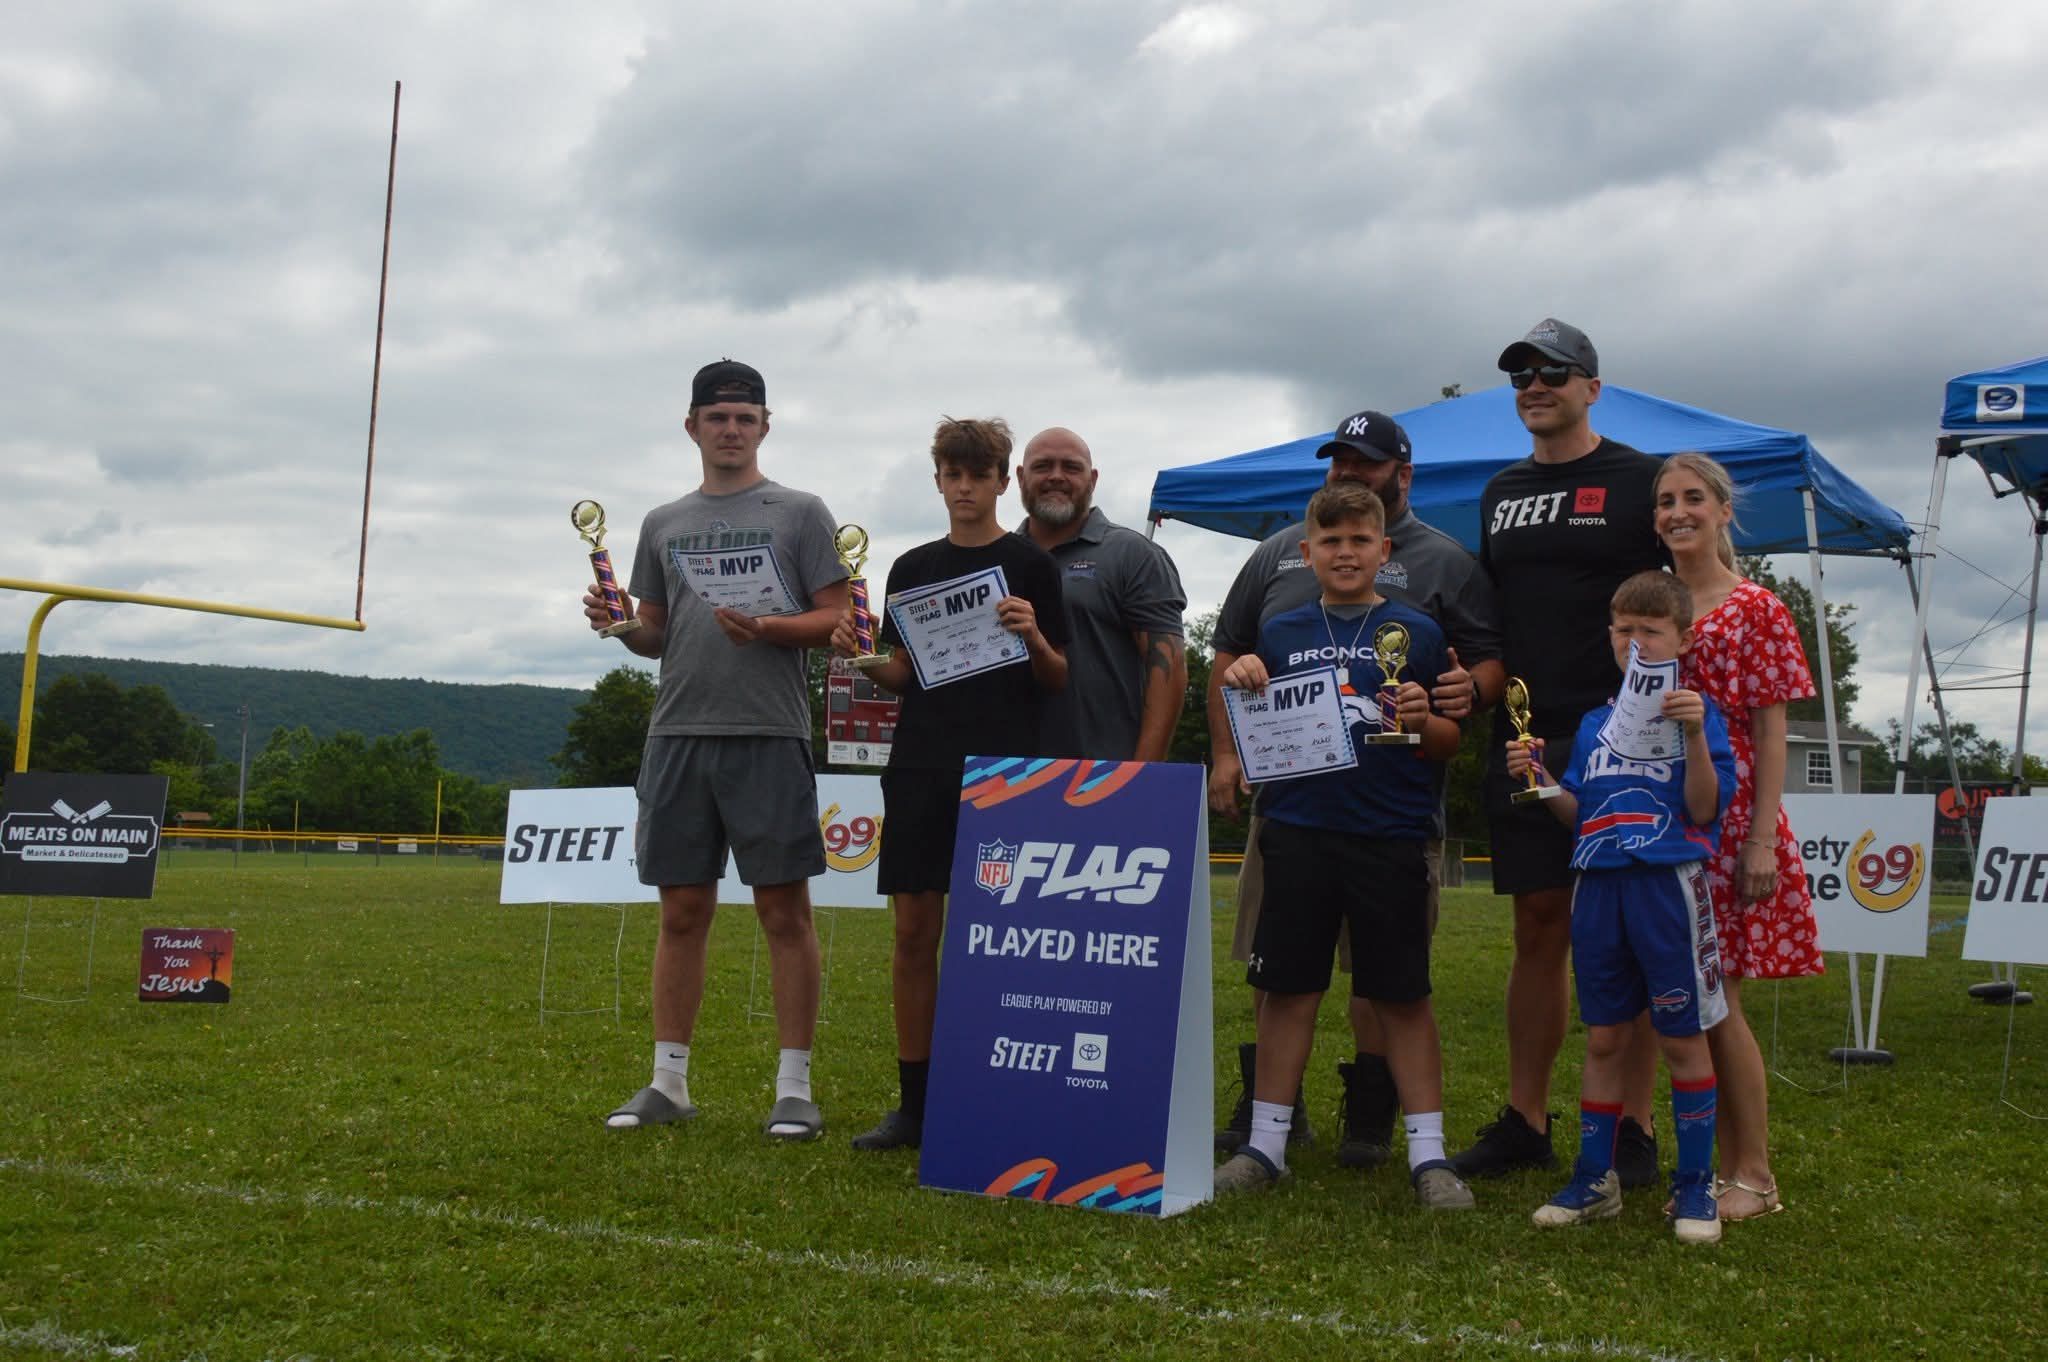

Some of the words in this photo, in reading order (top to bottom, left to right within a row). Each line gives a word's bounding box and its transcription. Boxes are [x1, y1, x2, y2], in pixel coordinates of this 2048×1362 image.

[1490, 491, 1568, 535] STEET
[720, 555, 763, 577] MVP
[944, 584, 990, 616] MVP
[1289, 646, 1399, 666] BRONC
[830, 685, 851, 694] HOME
[1274, 681, 1325, 712] MVP
[1249, 703, 1268, 714] FLAG
[9, 827, 67, 841] MEATS
[72, 828, 97, 842] ON
[101, 829, 148, 844] MAIN
[508, 824, 624, 863] STEET
[825, 816, 876, 852] 99
[26, 849, 56, 857] Market
[68, 850, 124, 859] Delicatessen
[1798, 834, 1850, 867] ety
[980, 863, 1010, 886] NFL
[1000, 841, 1170, 905] FLAG
[1858, 845, 1914, 889] 99
[1975, 846, 2048, 903] STE
[153, 934, 202, 949] Thank
[968, 923, 1075, 961] PLAYED
[1085, 931, 1159, 967] HERE
[164, 955, 190, 968] You
[141, 974, 208, 992] Jesus
[1001, 993, 1033, 1009] LEAGUE
[1034, 996, 1055, 1011] PLAY
[1056, 998, 1098, 1015] POWERED
[1100, 1001, 1112, 1015] BY
[990, 1036, 1061, 1072] STEET
[1065, 1076, 1109, 1090] TOYOTA
